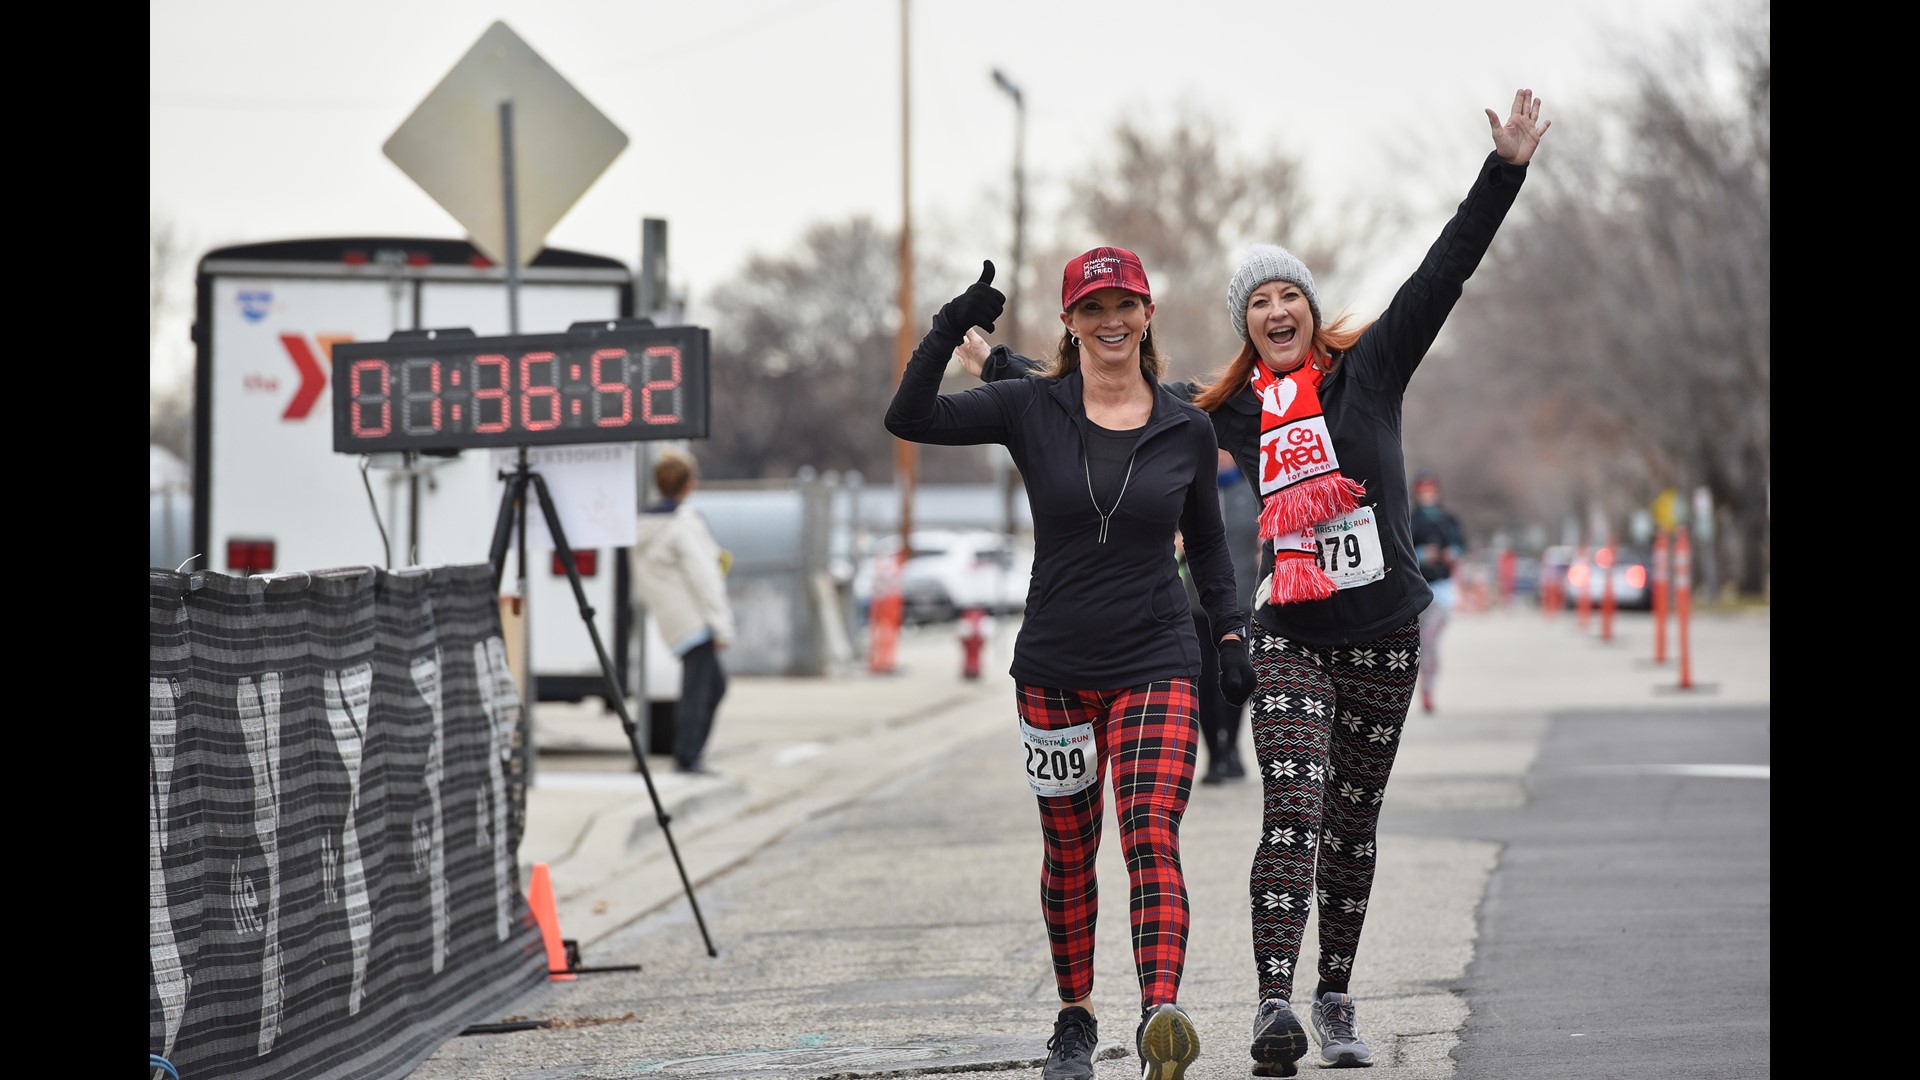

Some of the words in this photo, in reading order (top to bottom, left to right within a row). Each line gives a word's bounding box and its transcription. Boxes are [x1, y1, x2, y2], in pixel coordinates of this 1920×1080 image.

[1089, 257, 1120, 265] NAUGHTY
[350, 346, 682, 438] 01:36:52
[1287, 427, 1314, 446] Go
[1280, 433, 1328, 475] Red
[1287, 472, 1300, 481] for
[1303, 463, 1331, 476] women
[1314, 520, 1353, 534] HRISTMAS
[1353, 518, 1370, 527] RUN
[1024, 741, 1086, 780] 2209
